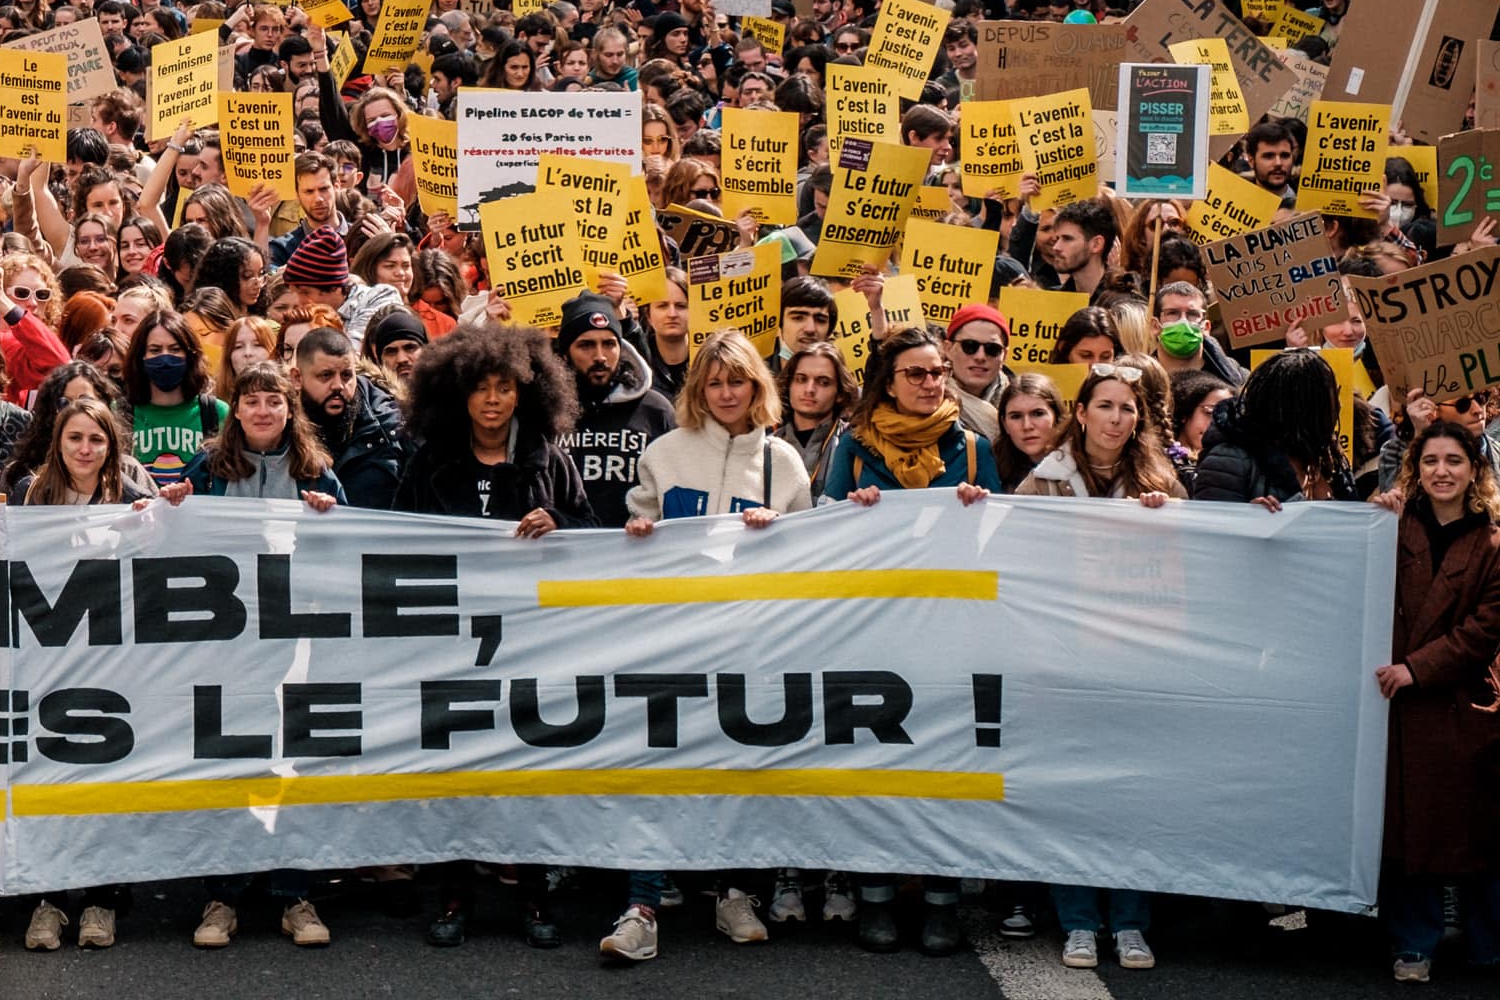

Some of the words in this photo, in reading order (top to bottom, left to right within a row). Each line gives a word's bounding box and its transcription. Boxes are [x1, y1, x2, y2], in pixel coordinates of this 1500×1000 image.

[385, 4, 424, 18] L'avenir,
[887, 1, 939, 32] L'avenir,
[385, 19, 407, 32] c'est
[409, 20, 418, 30] la
[885, 22, 917, 41] c'est
[918, 31, 931, 45] la
[985, 25, 1050, 43] DEPUIS
[379, 33, 414, 47] justice
[878, 37, 924, 62] justice
[179, 44, 192, 56] Le
[24, 58, 38, 72] Le
[158, 52, 213, 77] féminisme
[867, 52, 927, 82] climatique
[0, 72, 62, 90] féminisme
[177, 72, 193, 85] est
[832, 74, 891, 97] L'avenir,
[1136, 78, 1187, 88] L'ACTION
[21, 93, 39, 105] est
[158, 86, 198, 105] l'avenir
[197, 81, 213, 96] du
[0, 105, 42, 124] l'avenir
[45, 109, 61, 123] du
[158, 95, 212, 122] patriarcat
[227, 99, 282, 116] L'avenir,
[465, 108, 517, 120] Pipeline
[521, 108, 564, 118] EACOP
[568, 108, 584, 118] de
[587, 108, 622, 118] Total
[837, 97, 872, 113] c'est
[875, 100, 887, 114] la
[1019, 101, 1085, 128] L'avenir,
[1140, 102, 1184, 115] PISSER
[1, 124, 59, 140] patriarcat
[230, 117, 258, 131] c'est
[263, 119, 279, 131] un
[837, 118, 884, 134] justice
[1316, 112, 1382, 134] L'avenir,
[227, 132, 285, 149] logement
[502, 134, 517, 142] 20
[519, 133, 542, 142] fois
[545, 133, 575, 142] Paris
[730, 134, 748, 150] Le
[751, 135, 788, 153] futur
[1029, 128, 1065, 147] c'est
[1069, 124, 1083, 138] la
[1319, 133, 1355, 151] c'est
[1361, 138, 1375, 151] la
[225, 148, 256, 164] digne
[260, 151, 290, 166] pour
[464, 148, 513, 156] réserves
[579, 148, 634, 156] détruites
[1034, 145, 1084, 171] justice
[233, 165, 282, 180] tous·tes
[735, 153, 781, 173] s'écrit
[1316, 154, 1371, 174] justice
[546, 168, 621, 197] L'avenir,
[724, 176, 794, 194] ensemble
[592, 197, 613, 216] la
[495, 230, 518, 249] Le
[521, 220, 565, 244] futur
[506, 246, 564, 271] s'écrit
[912, 250, 935, 269] Le
[939, 254, 983, 276] futur
[1206, 242, 1242, 266] LA
[1273, 251, 1292, 268] LA
[700, 282, 726, 301] Le
[729, 272, 771, 296] futur
[916, 276, 972, 299] s'écrit
[1217, 274, 1285, 303] VOULEZ
[1288, 256, 1339, 284] BLEU
[1356, 258, 1500, 324] DESTROY
[708, 298, 764, 323] s'écrit
[1232, 310, 1281, 339] BIEN
[1283, 294, 1338, 324] CUITE
[1421, 364, 1461, 397] the
[193, 682, 362, 760] LE
[419, 671, 914, 750] FUTUR
[974, 674, 1004, 748] !
